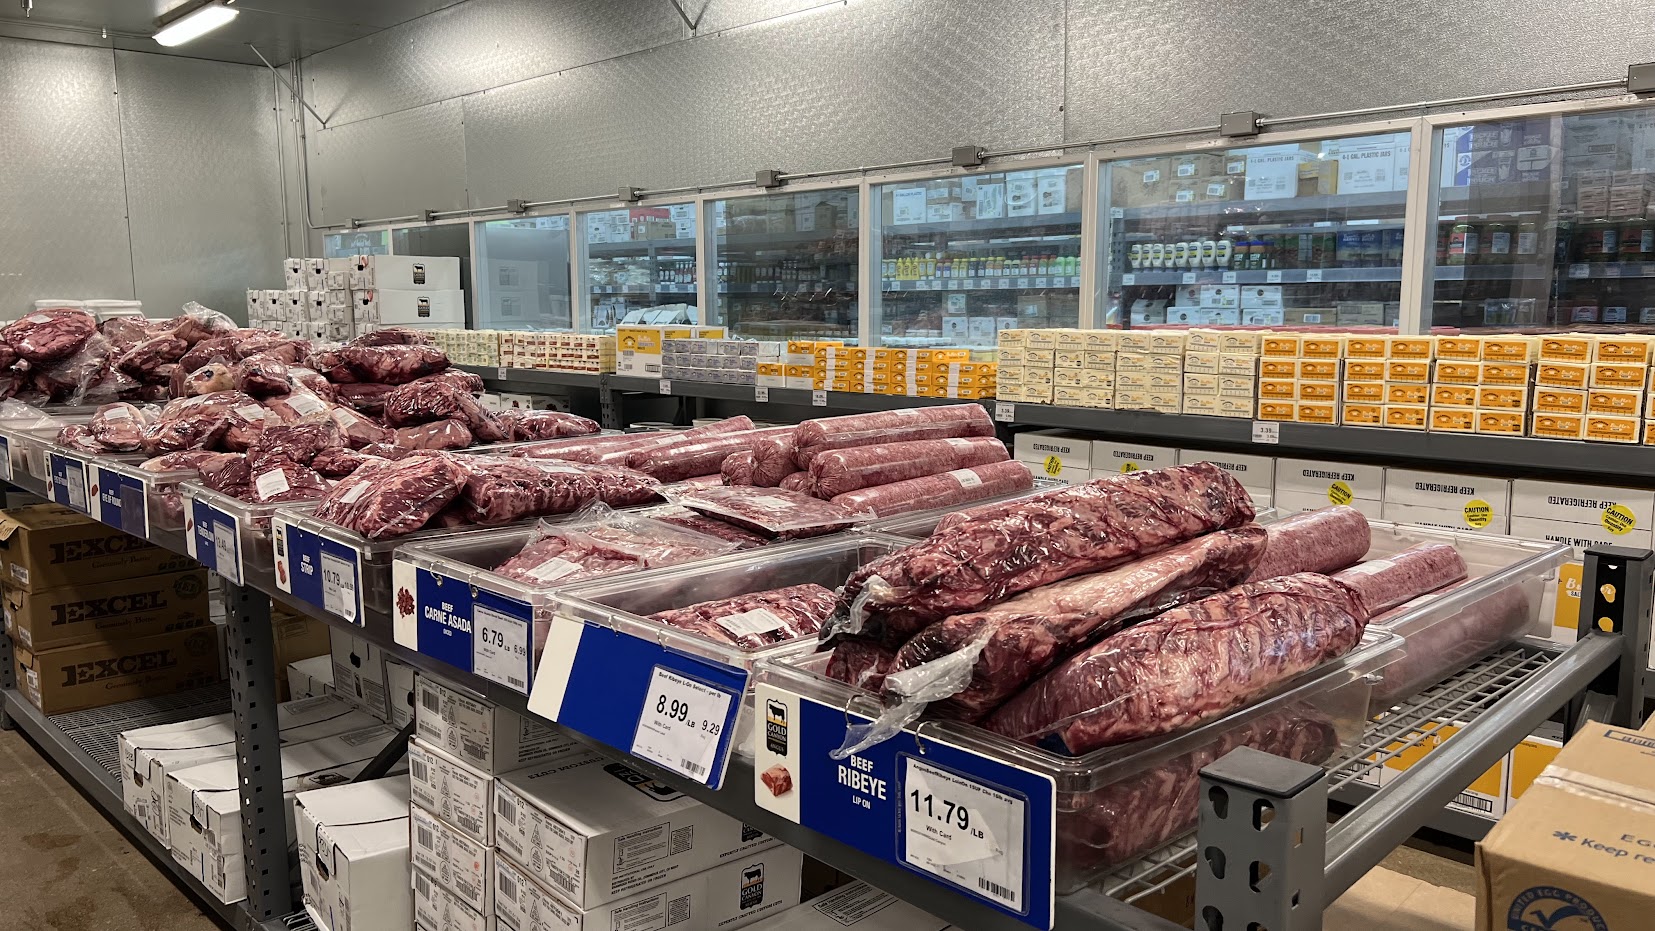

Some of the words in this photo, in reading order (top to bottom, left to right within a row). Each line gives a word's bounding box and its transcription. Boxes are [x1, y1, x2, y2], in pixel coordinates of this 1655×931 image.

[1113, 450, 1142, 460] REFRIGERATED
[1303, 469, 1341, 480] REFRIGERATED
[1342, 473, 1354, 481] KEEP
[1332, 484, 1351, 499] CAUTION
[1415, 482, 1458, 494] REFRIGERATED
[1460, 487, 1475, 495] KEEP
[1548, 496, 1597, 508] REFRIGERATED
[1606, 508, 1634, 525] CAUTION
[1574, 538, 1592, 547] WITH
[301, 562, 313, 576] STRIP
[323, 569, 340, 586] 10.79
[51, 591, 168, 626] EXCEL
[442, 602, 453, 612] BEEF
[424, 606, 447, 625] CARNE
[448, 615, 472, 634] ASADA
[482, 627, 504, 648] 6.79
[62, 651, 178, 687] EXCEL
[656, 695, 688, 721] 8.99
[702, 720, 720, 735] 9.29
[768, 723, 786, 735] GOLD
[768, 731, 786, 741] CANYON
[851, 755, 873, 772] BEEF
[838, 765, 886, 800] RIBEYE
[853, 795, 861, 805] LIP
[862, 799, 870, 809] ON
[910, 789, 969, 830] 11.79
[970, 827, 984, 839] /LB
[926, 825, 938, 835] With
[939, 830, 952, 840] Card
[1581, 838, 1628, 857] Keep
[742, 884, 762, 896] GOLD
[742, 891, 762, 901] CANYON
